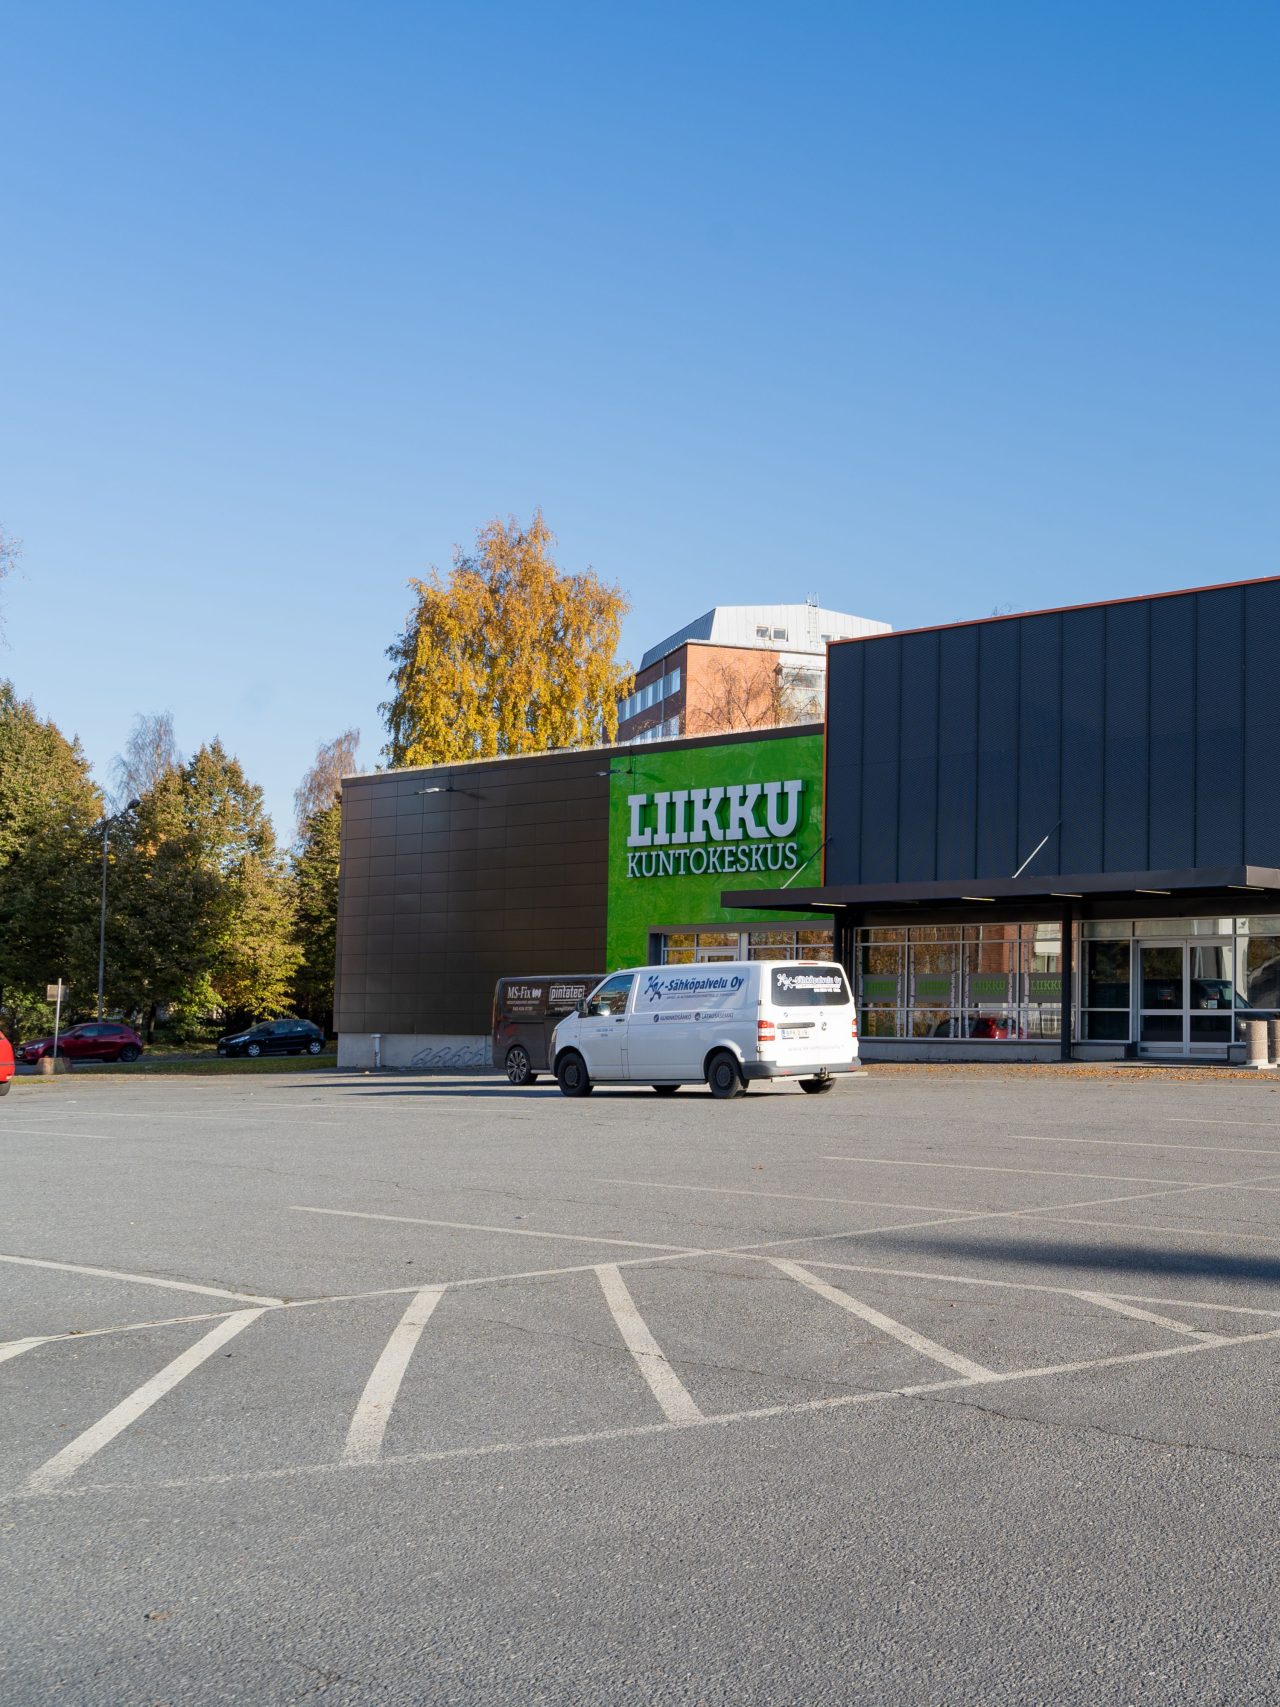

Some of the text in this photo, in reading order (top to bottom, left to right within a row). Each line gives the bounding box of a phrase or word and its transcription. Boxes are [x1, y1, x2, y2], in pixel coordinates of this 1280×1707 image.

[627, 780, 803, 847] LIIKKU
[627, 842, 798, 878] KUNTOKESKUS
[731, 976, 745, 991] Oy
[507, 986, 531, 999] MS-Fix
[550, 985, 583, 1000] pintatec
